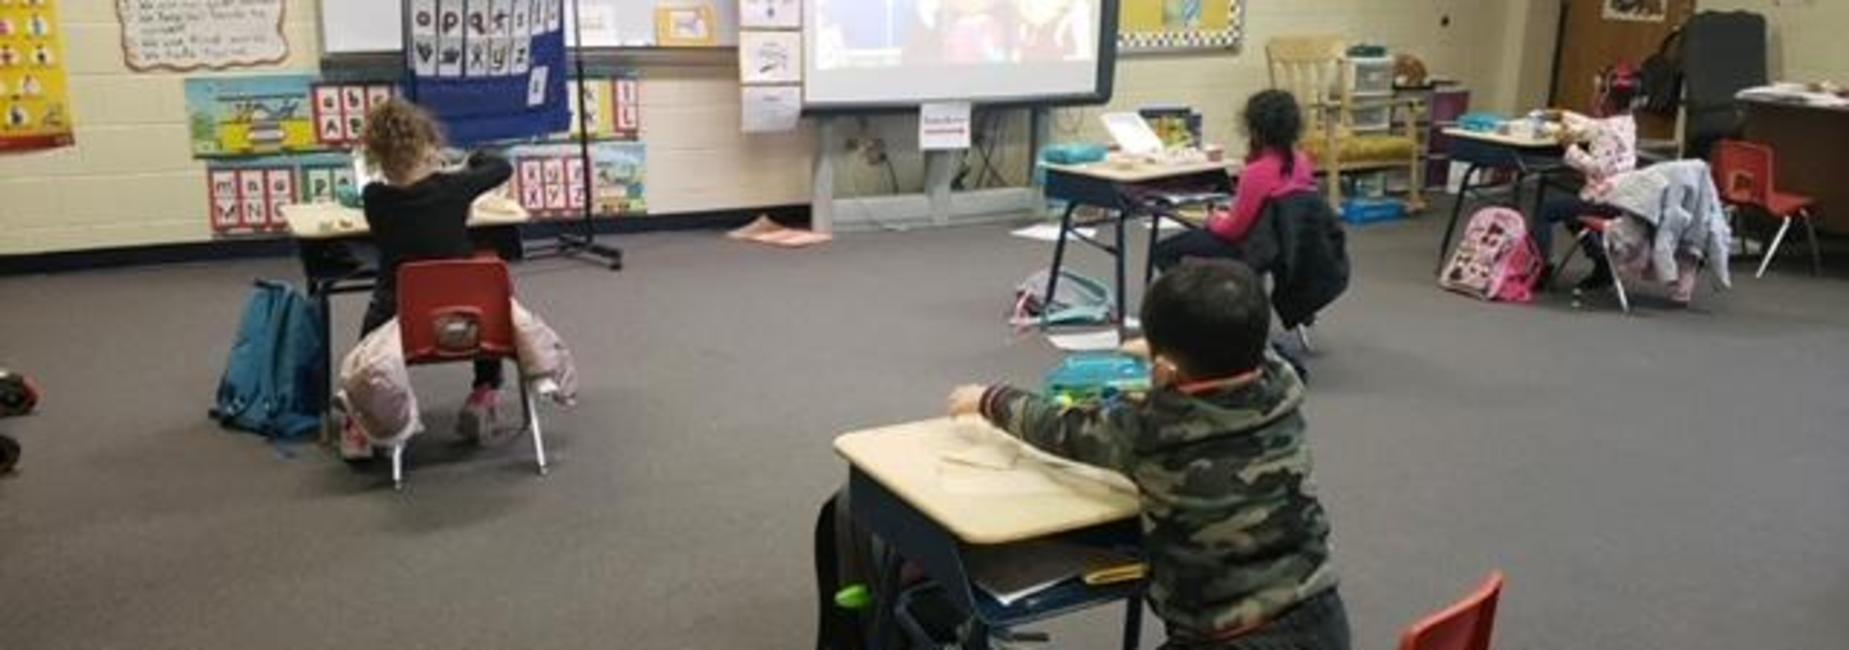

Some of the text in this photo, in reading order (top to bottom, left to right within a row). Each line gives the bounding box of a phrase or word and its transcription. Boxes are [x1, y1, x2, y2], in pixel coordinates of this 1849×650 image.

[416, 11, 430, 27] o
[442, 11, 458, 33] p
[491, 46, 506, 70] y
[347, 90, 359, 108] b
[326, 119, 339, 135] A
[247, 181, 259, 192] n
[314, 178, 327, 197] p
[217, 204, 236, 219] M
[247, 202, 262, 218] N
